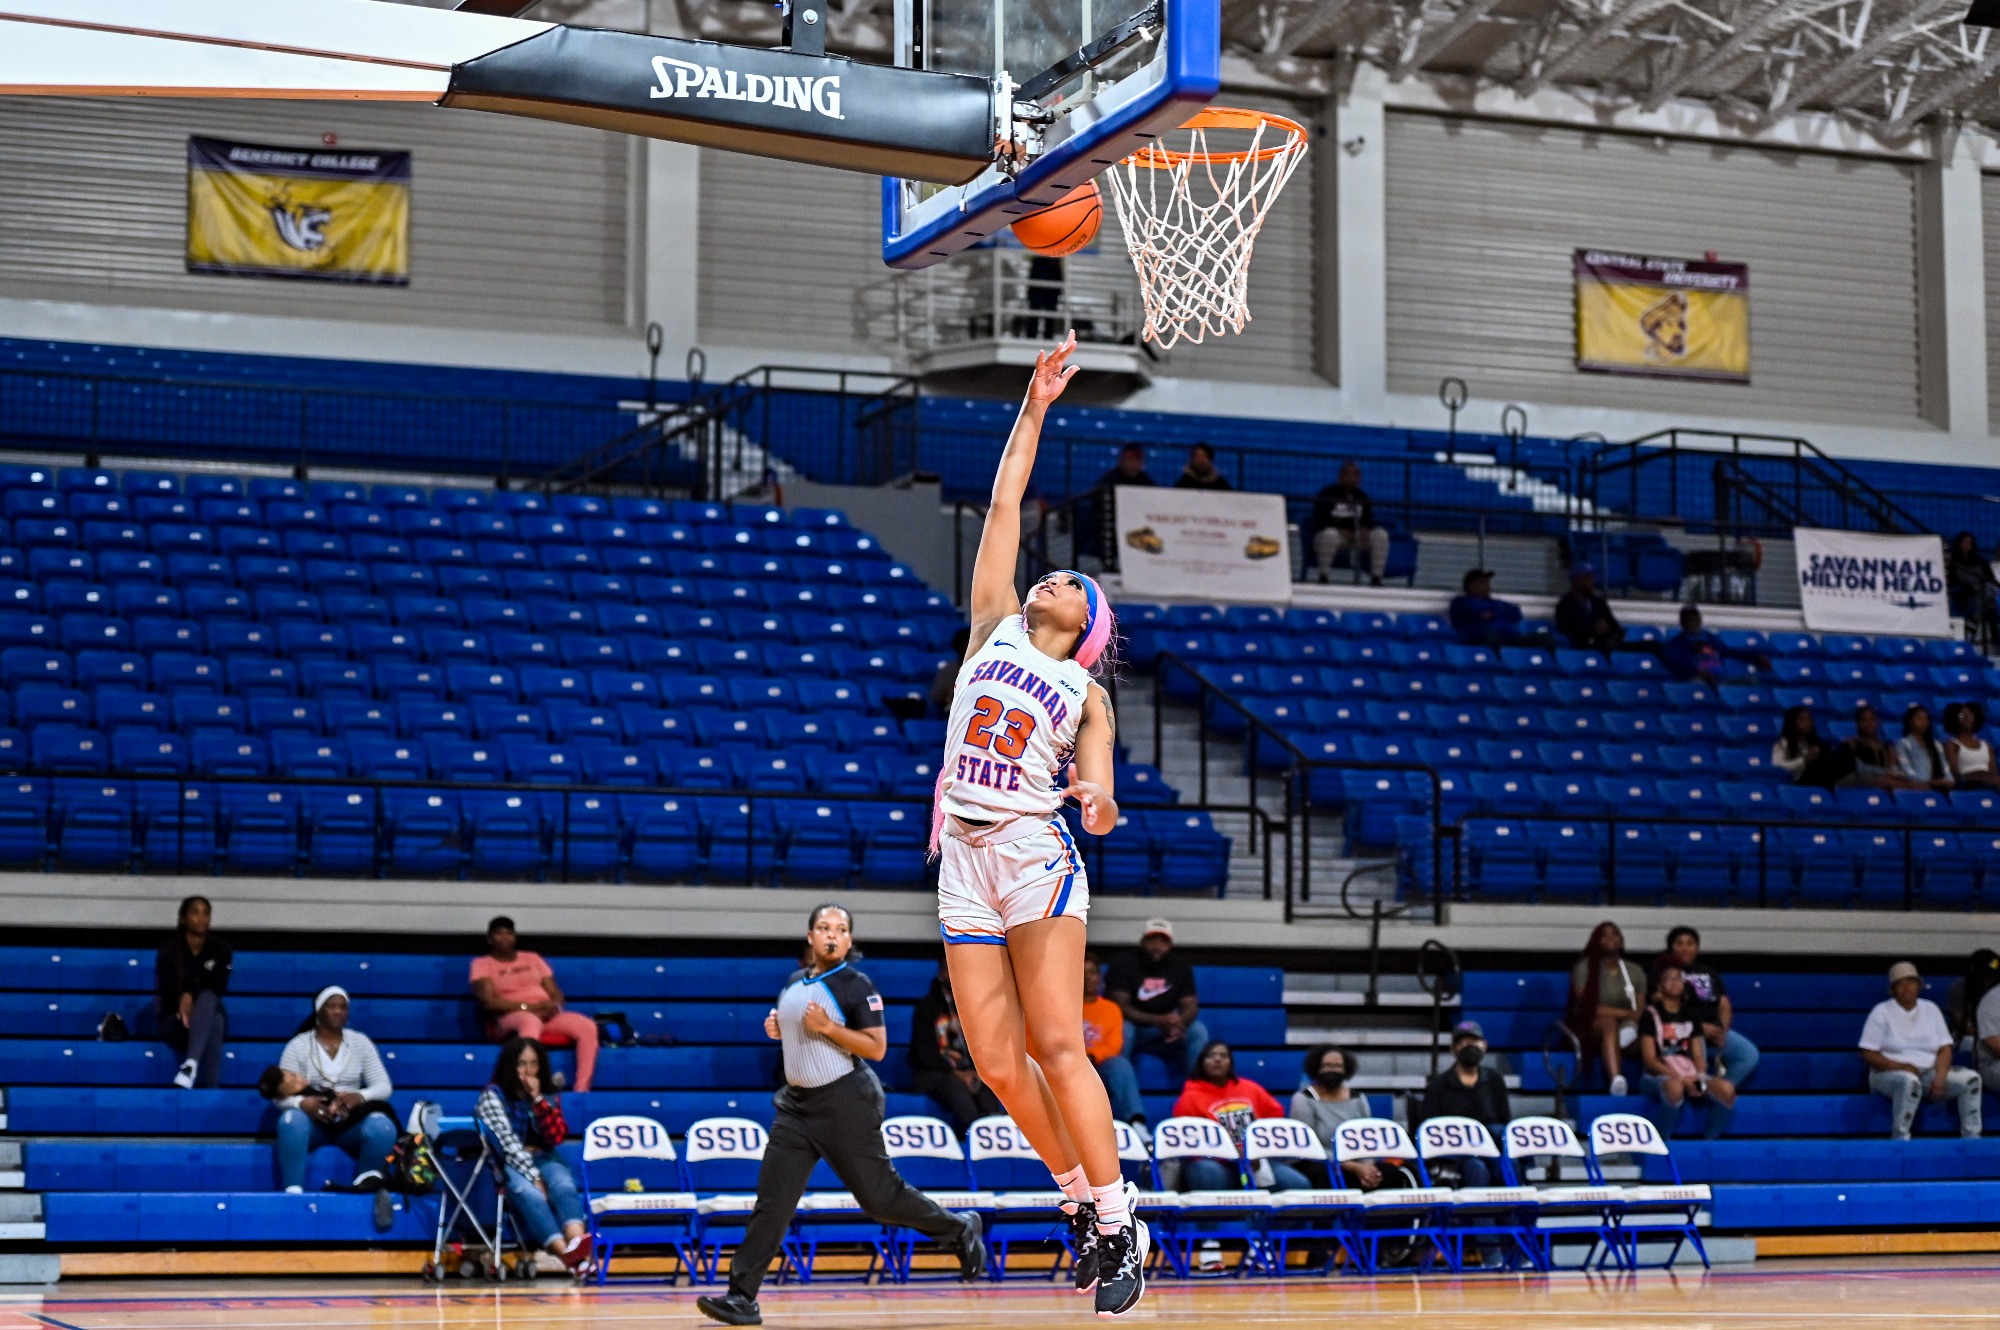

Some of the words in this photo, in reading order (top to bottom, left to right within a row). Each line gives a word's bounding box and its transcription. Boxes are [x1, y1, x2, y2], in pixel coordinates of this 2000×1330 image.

[650, 56, 845, 120] SPALDING
[310, 153, 379, 170] COLLEGE
[1809, 553, 1932, 575] SAVANNAH
[1802, 571, 1876, 590] HILTON
[1883, 576, 1942, 593] HEAD
[968, 660, 1067, 733] SAVANNAH
[1058, 679, 1081, 697] SIAC
[963, 694, 1036, 760] 23
[956, 754, 1022, 792] STATE
[592, 1125, 658, 1149] SSU
[695, 1127, 761, 1151] SSU
[885, 1124, 947, 1149] SSU
[1162, 1125, 1222, 1148] SSU
[1252, 1126, 1311, 1149] SSU
[1341, 1127, 1400, 1150] SSU
[1425, 1125, 1484, 1147] SSU
[1511, 1125, 1568, 1147] SSU
[1597, 1122, 1652, 1145] SSU
[634, 1199, 676, 1209] TIGERS
